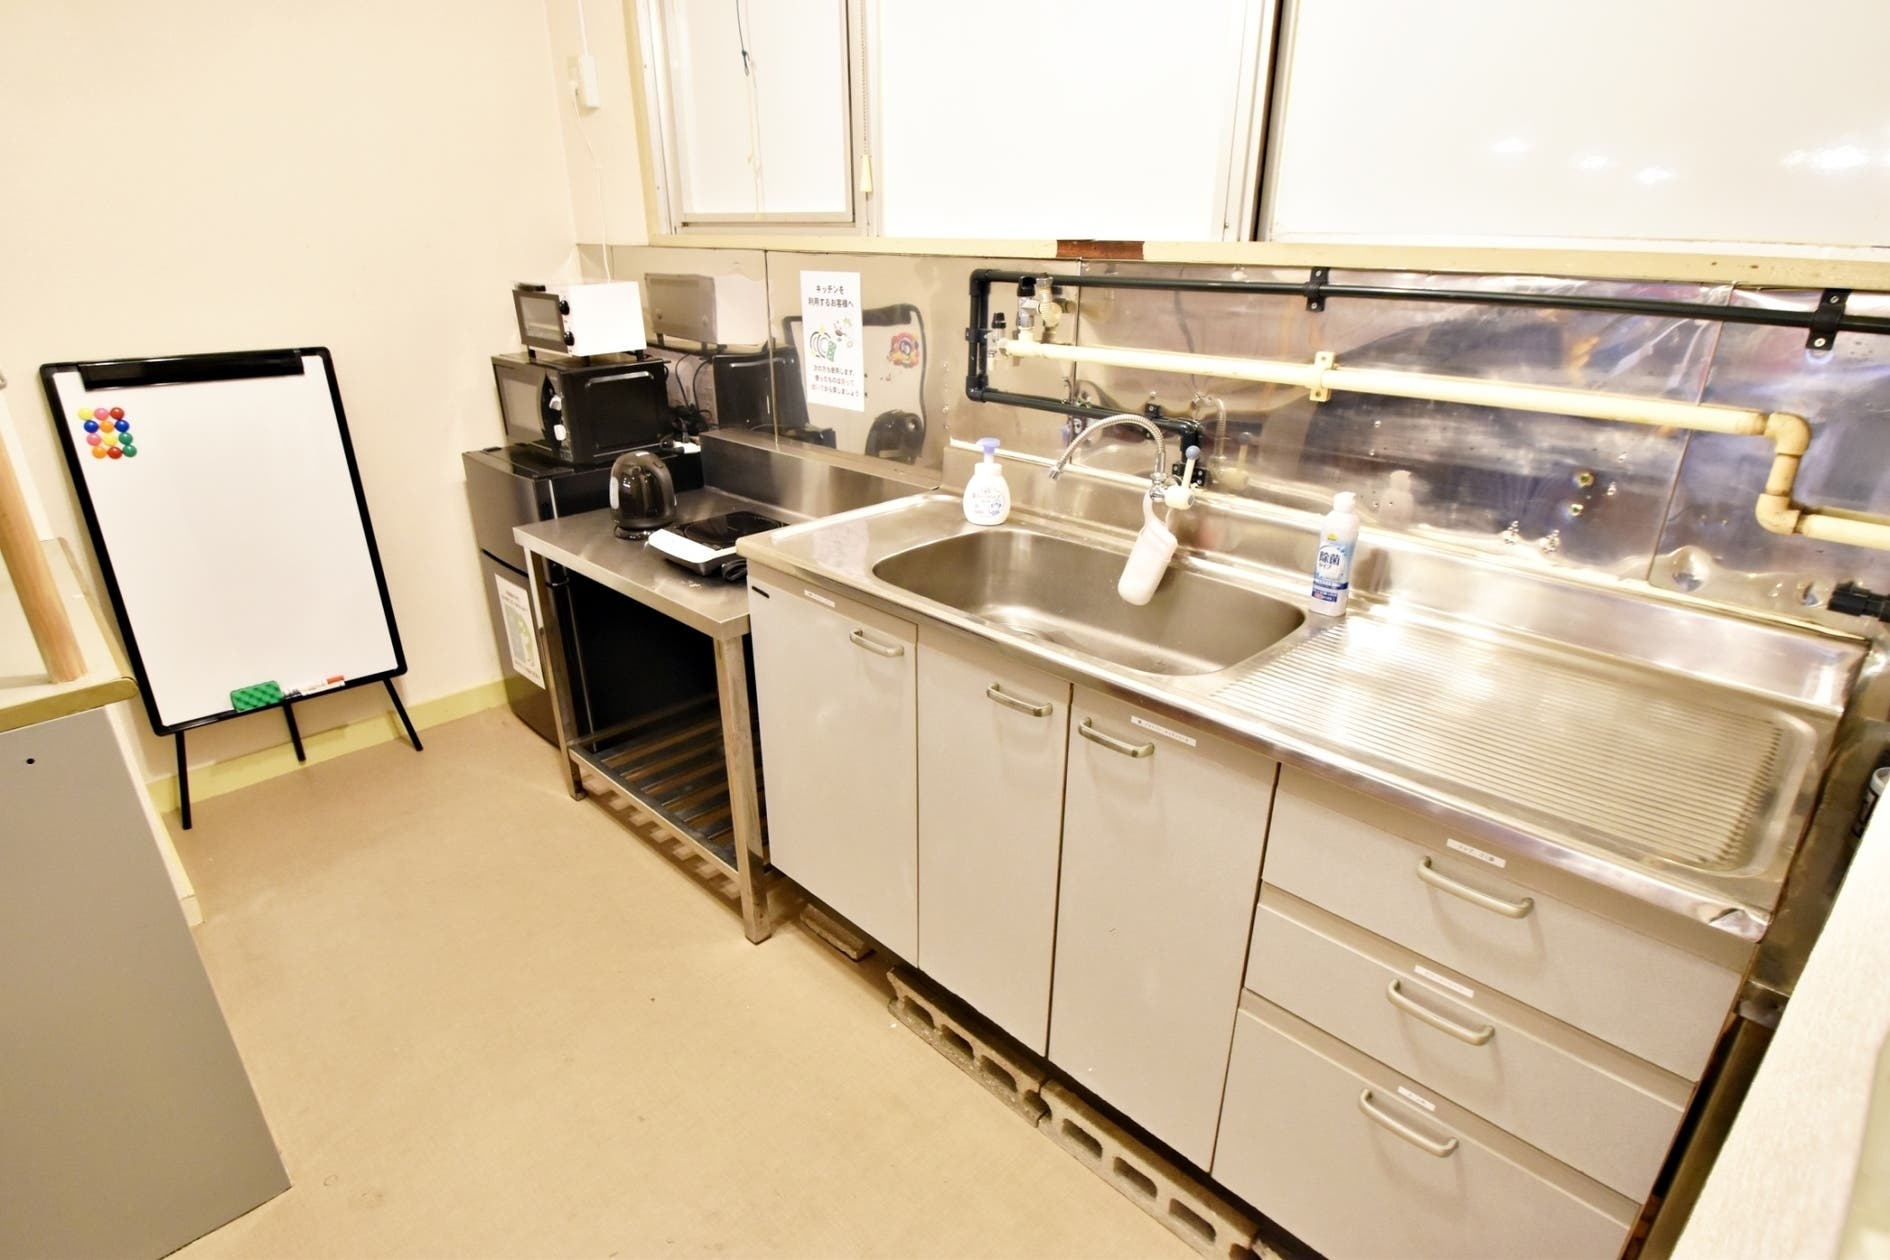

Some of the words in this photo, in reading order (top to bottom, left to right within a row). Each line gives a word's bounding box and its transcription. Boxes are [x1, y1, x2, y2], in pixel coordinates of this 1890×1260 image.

[816, 284, 844, 295] キッチンを
[1319, 551, 1340, 565] 除菌
